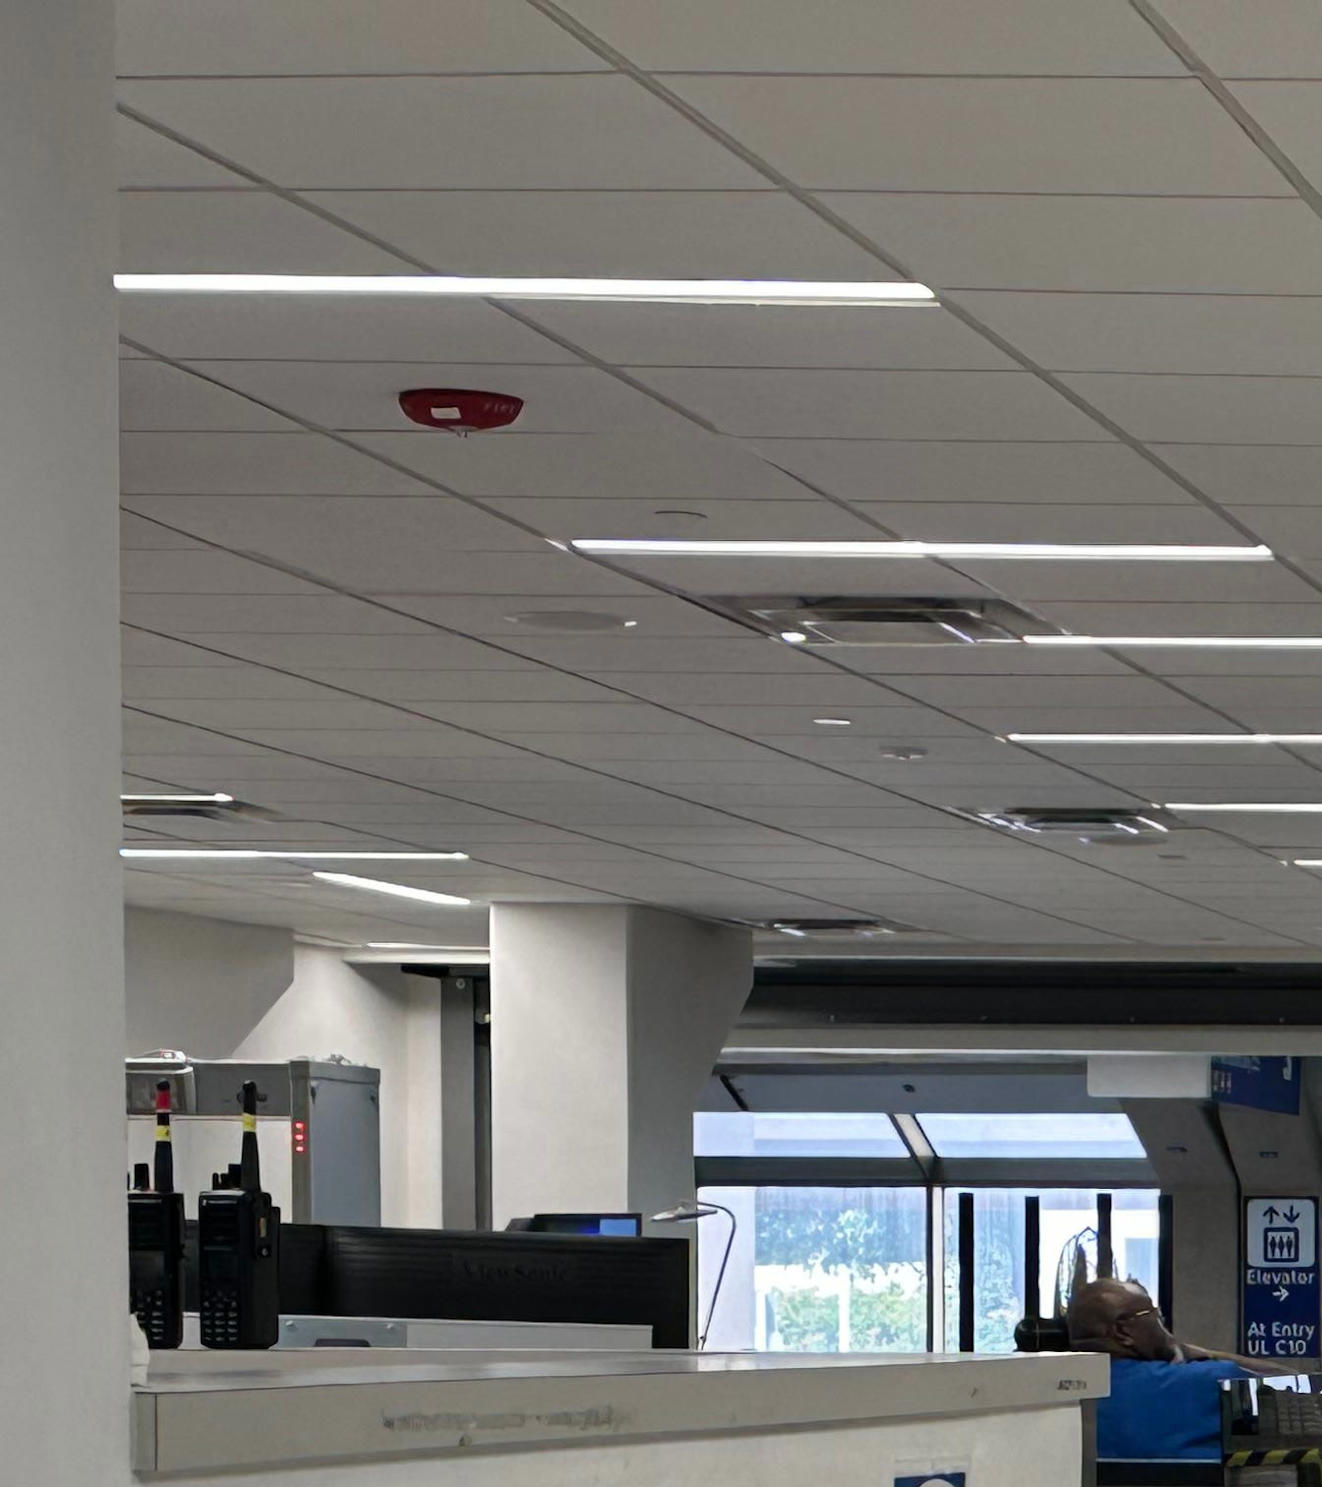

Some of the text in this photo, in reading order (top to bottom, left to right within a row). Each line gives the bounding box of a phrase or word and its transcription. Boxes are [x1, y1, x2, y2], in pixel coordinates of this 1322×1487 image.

[1246, 1269, 1315, 1285] Elevator
[1248, 1321, 1315, 1340] At Entry
[1248, 1340, 1307, 1355] UL C10
